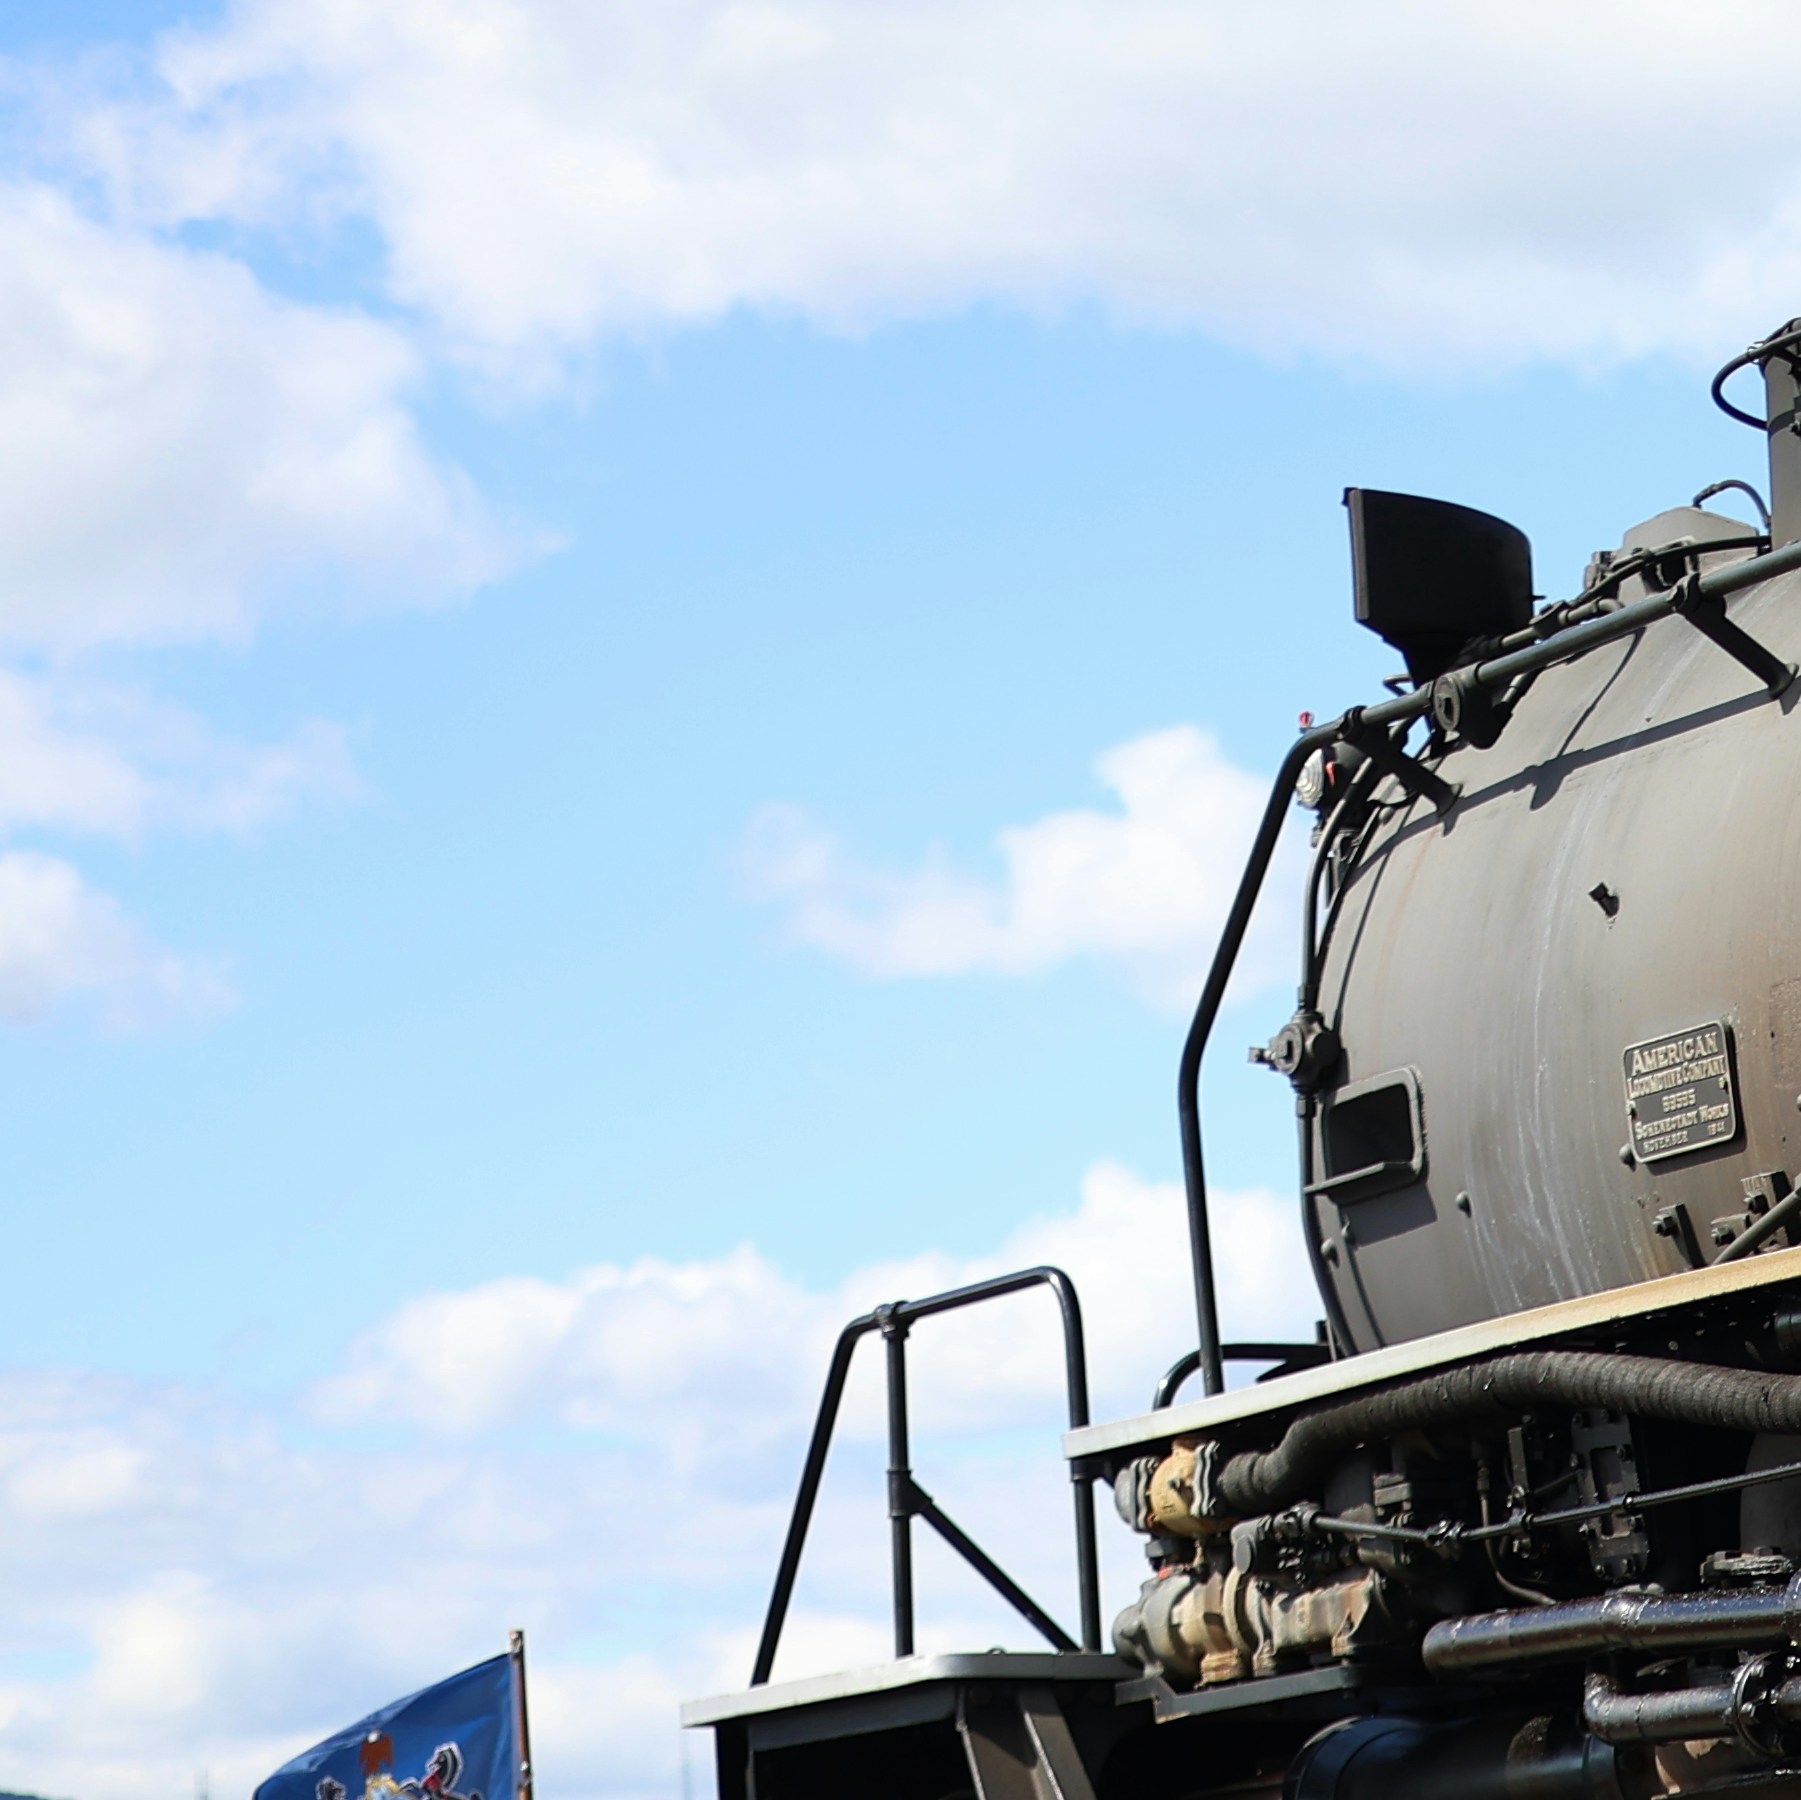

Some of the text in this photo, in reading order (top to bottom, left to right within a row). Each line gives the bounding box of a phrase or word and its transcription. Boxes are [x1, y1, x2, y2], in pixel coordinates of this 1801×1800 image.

[1632, 1032, 1718, 1075] AMERICAN
[1627, 1055, 1726, 1099] LOCOMOTIVE COMPANY
[1634, 1103, 1729, 1140] SCHENECTADY WORKS
[1643, 1130, 1689, 1153] NOVEMBER
